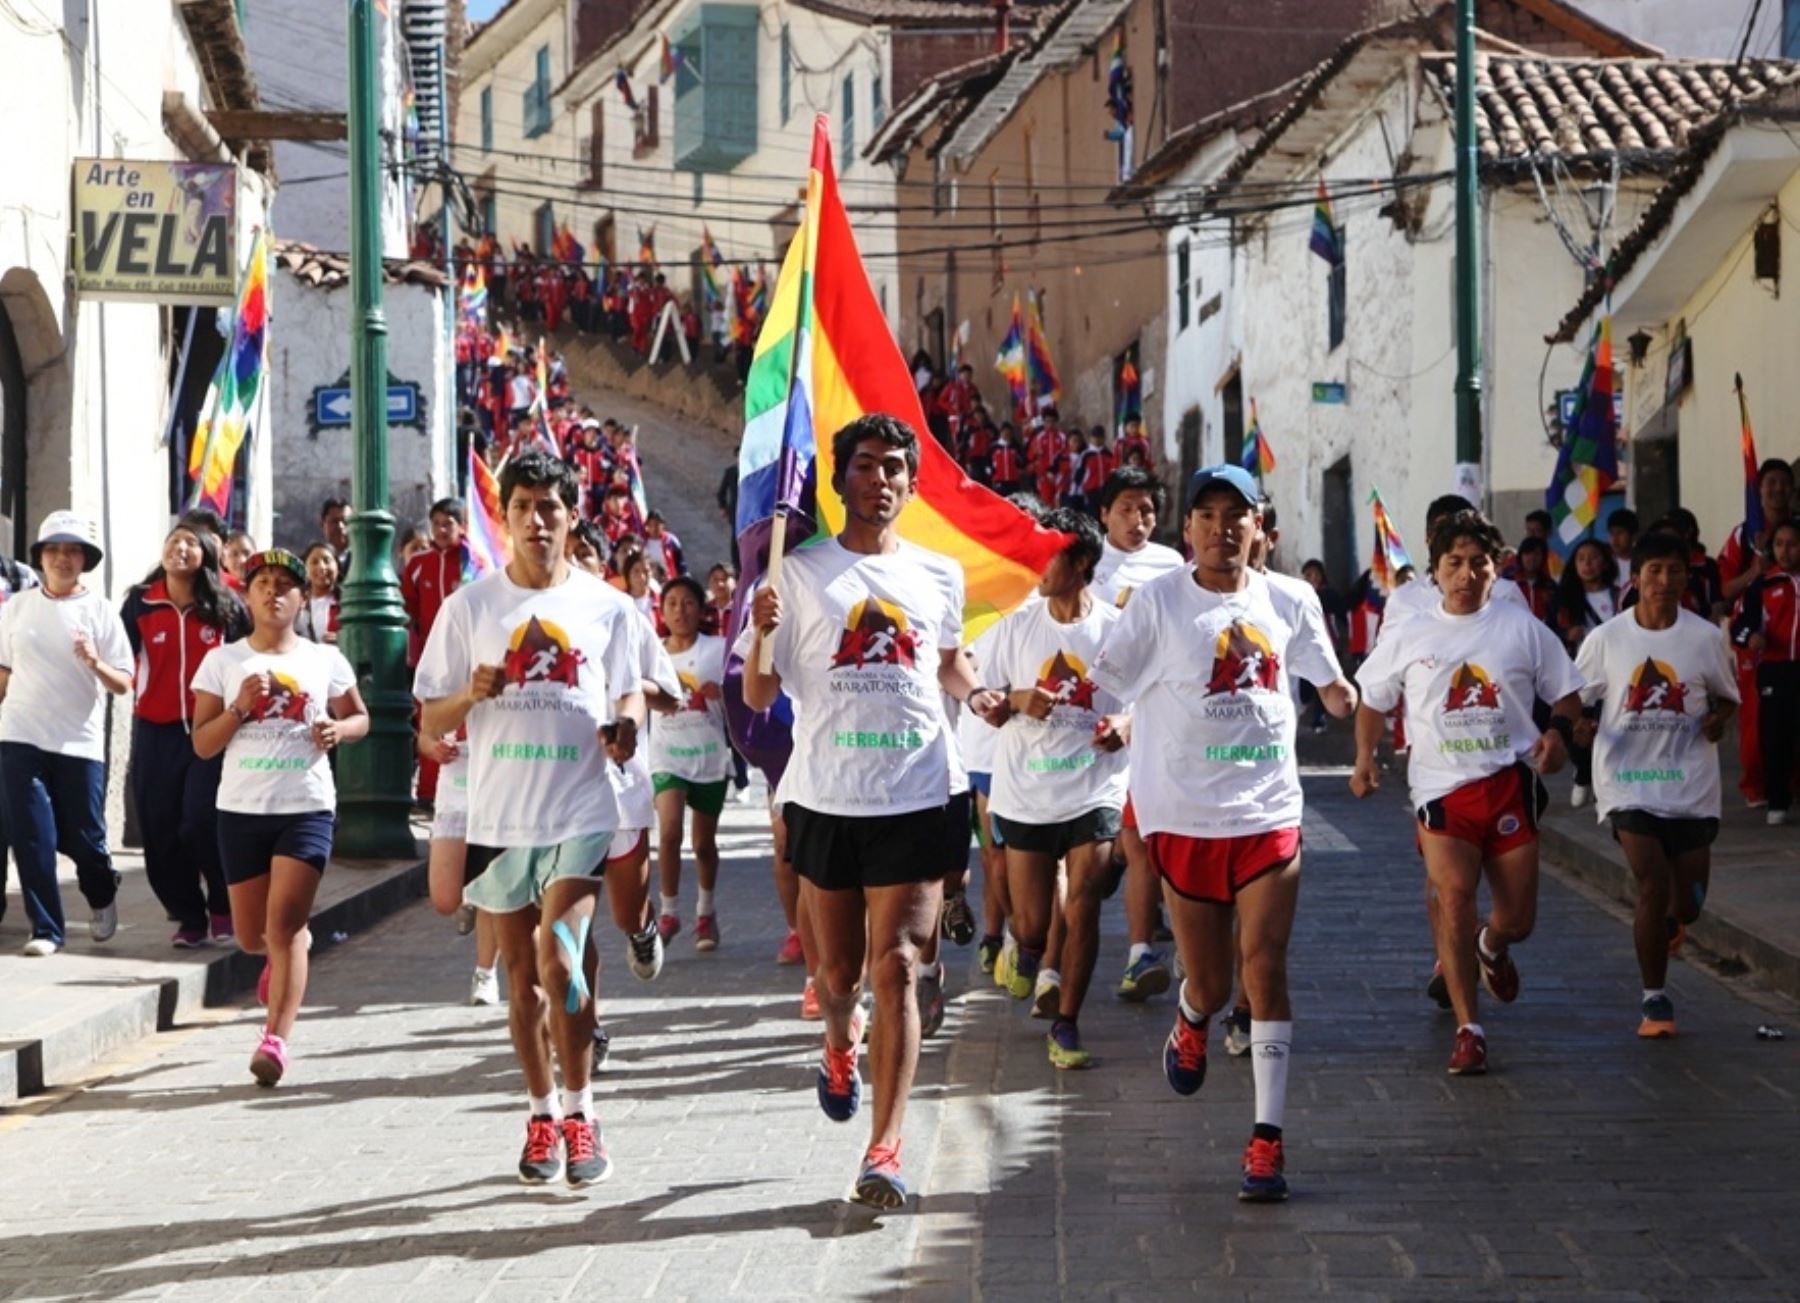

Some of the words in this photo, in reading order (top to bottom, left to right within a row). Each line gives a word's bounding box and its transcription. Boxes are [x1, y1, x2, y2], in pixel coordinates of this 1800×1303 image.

[86, 163, 141, 187] Arte
[125, 190, 154, 208] en
[82, 210, 229, 276] VELA
[492, 743, 579, 761] HERBALIFE
